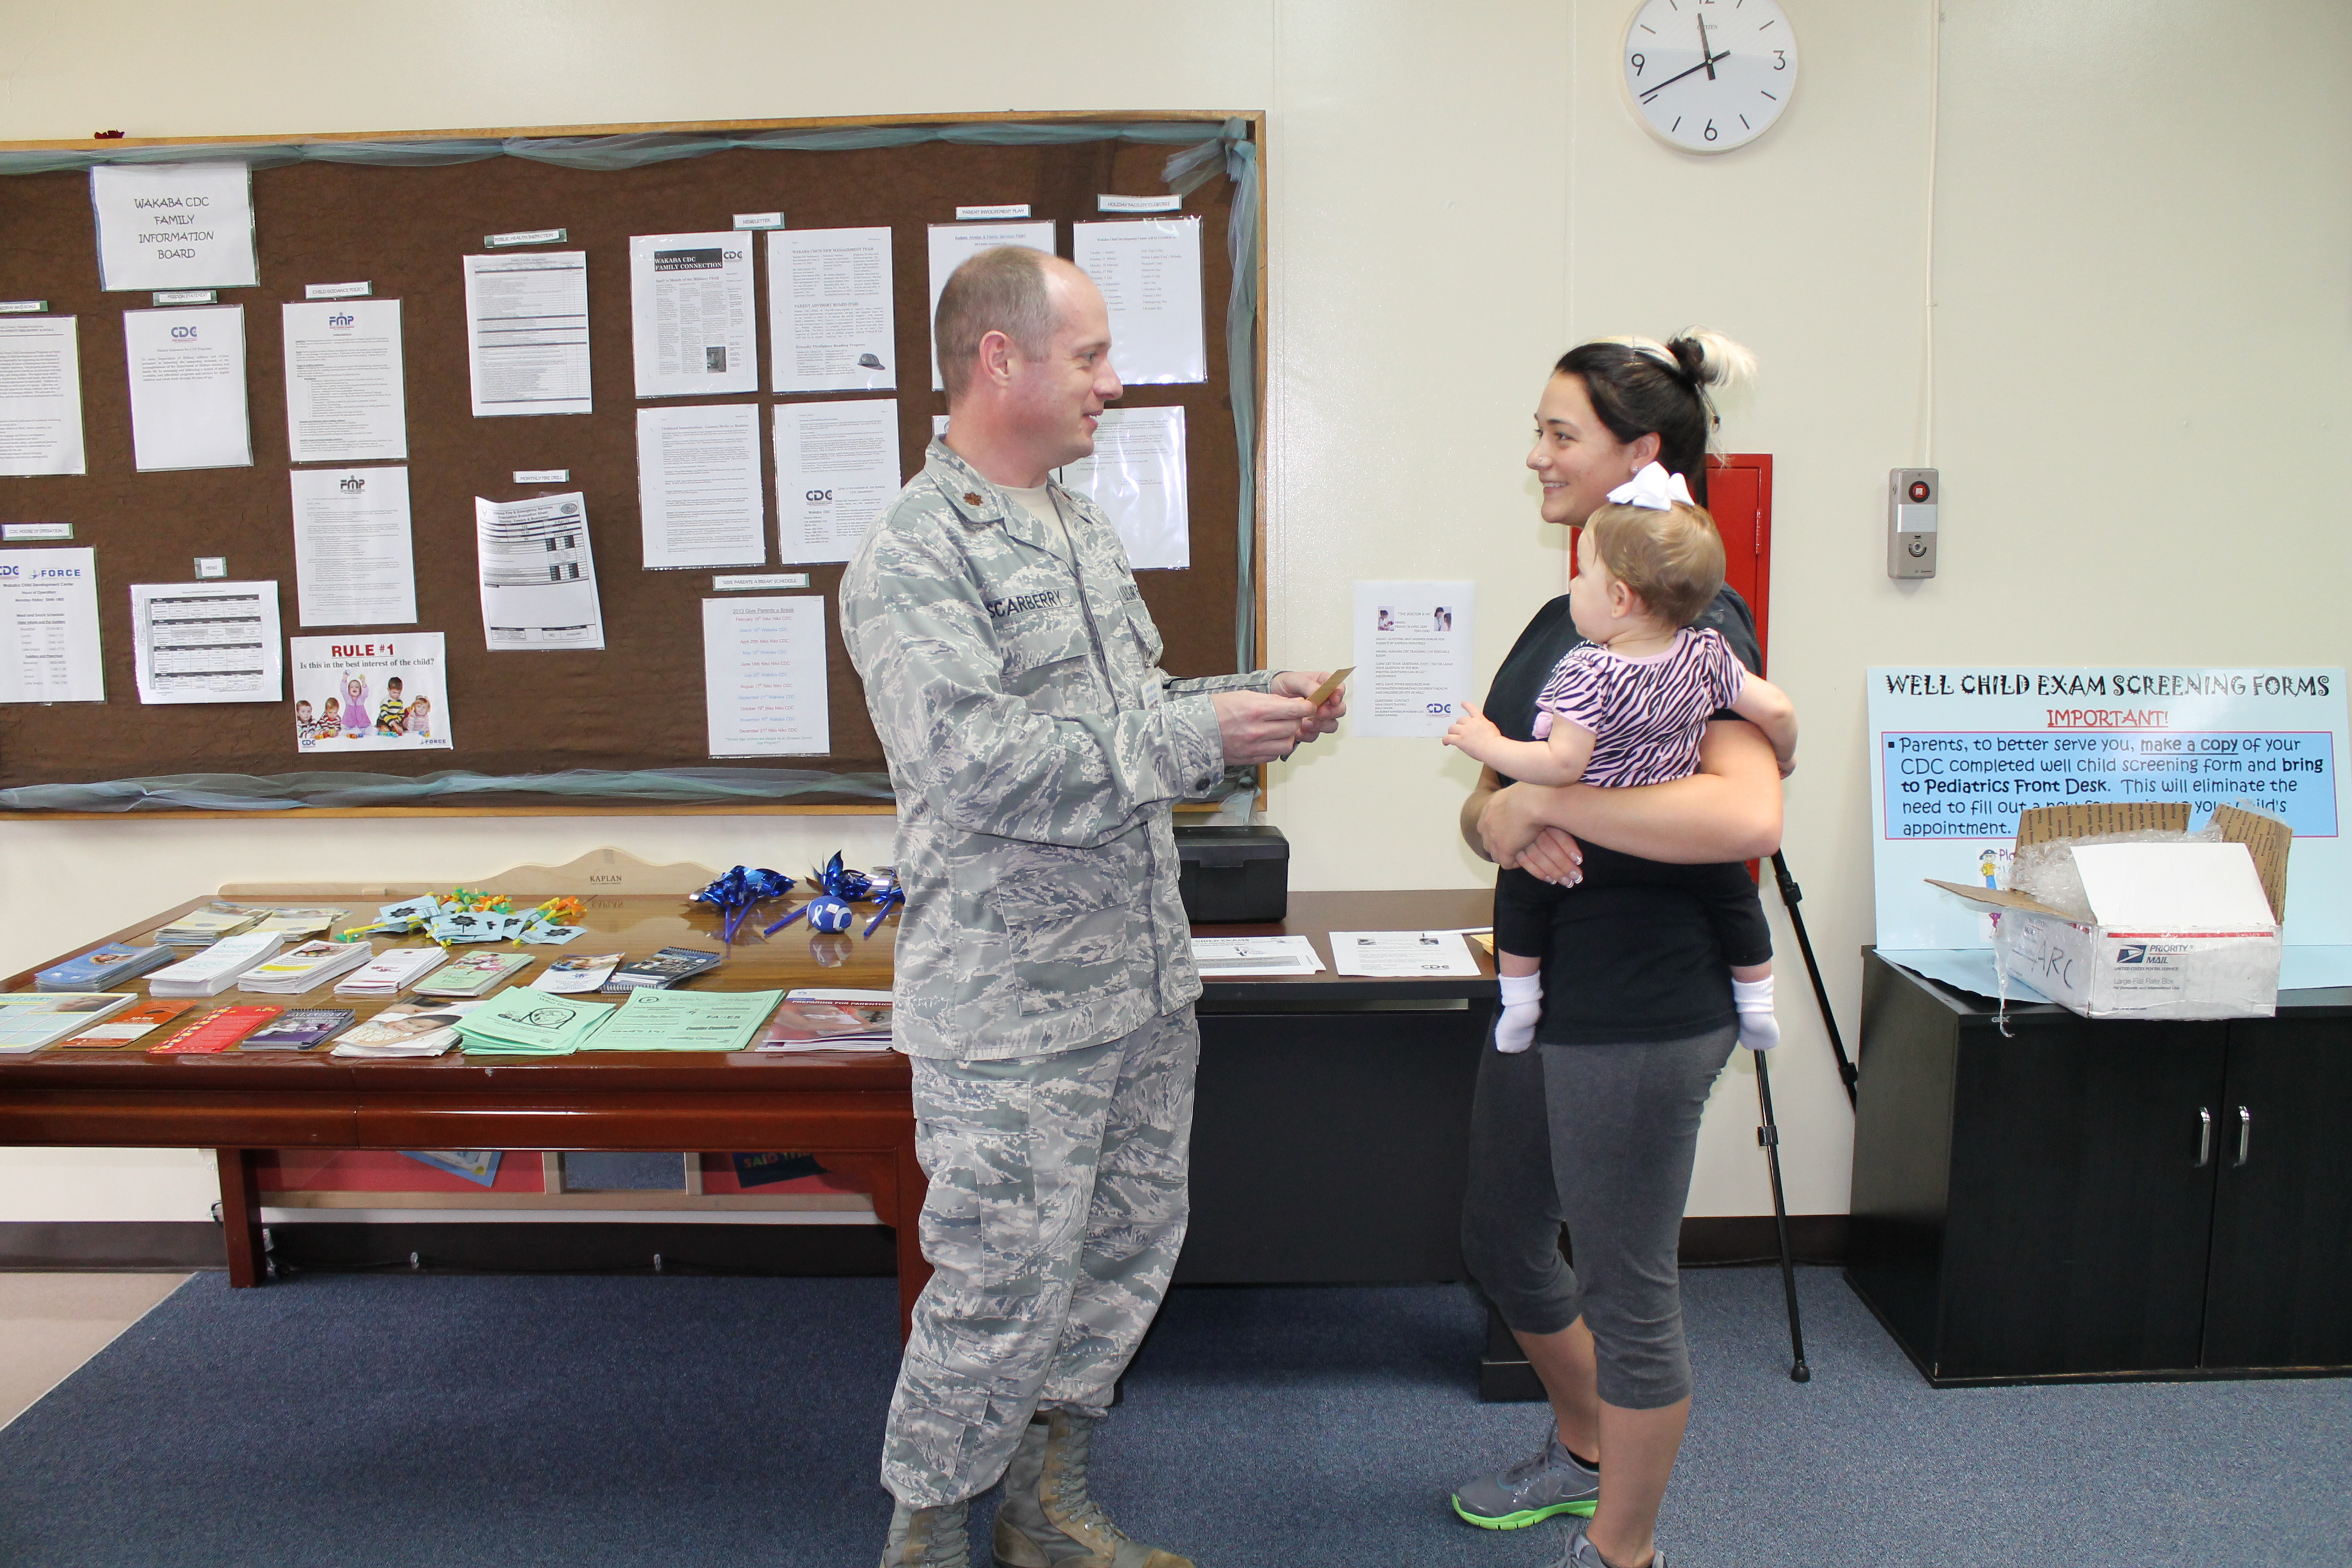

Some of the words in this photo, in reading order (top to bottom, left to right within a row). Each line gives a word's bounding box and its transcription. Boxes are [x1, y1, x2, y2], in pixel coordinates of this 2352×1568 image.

[1631, 53, 1645, 77] 9
[1773, 50, 1785, 70] 3
[1704, 118, 1718, 141] 6
[134, 198, 183, 209] WAKABA
[186, 197, 210, 207] CDC
[154, 215, 195, 225] FAMILY
[139, 231, 214, 243] INFORMATION
[157, 249, 195, 259] BOARD
[723, 251, 743, 259] CDC
[329, 315, 355, 326] FMP
[171, 326, 198, 338] CDC
[340, 479, 366, 489] FMP
[805, 489, 832, 501] CDC
[986, 590, 1062, 619] SCARBERRY
[331, 644, 375, 657] RULE
[379, 644, 394, 656] #1
[1886, 674, 1954, 695] WELL
[1960, 673, 2030, 695] CHILD
[2037, 674, 2106, 697] EXAM
[2112, 673, 2247, 697] SCREENING
[2253, 673, 2330, 698] FORMS
[1427, 704, 1451, 714] CDC
[2046, 709, 2169, 727] IMPORTANT!
[1899, 737, 1968, 753] Parents,
[1973, 739, 1992, 752] to
[1997, 737, 2049, 752] better
[2054, 739, 2097, 752] serve
[2101, 738, 2135, 753] you,
[2140, 738, 2182, 752] make
[2187, 740, 2196, 752] a
[2200, 739, 2239, 754] copy
[2242, 738, 2261, 751] of
[2265, 738, 2301, 753] your
[1901, 758, 1945, 775] CDC
[1949, 758, 2035, 774] completed
[2040, 758, 2071, 772] well
[2076, 758, 2116, 772] child
[2121, 758, 2198, 774] screening
[2203, 758, 2242, 773] form
[2247, 758, 2276, 772] and
[2282, 757, 2324, 774] bring
[1901, 780, 1920, 792] to
[1924, 778, 2010, 795] Pediatrics
[2013, 778, 2061, 795] Front
[2065, 778, 2111, 796] Desk.
[2121, 778, 2156, 794] This
[2161, 778, 2187, 793] will
[2192, 778, 2266, 793] eliminate
[2269, 778, 2297, 792] the
[1903, 800, 1941, 814] need
[1947, 802, 1966, 814] to
[1970, 800, 1992, 815] fill
[1997, 802, 2027, 814] out
[1903, 820, 2011, 836] appointment.
